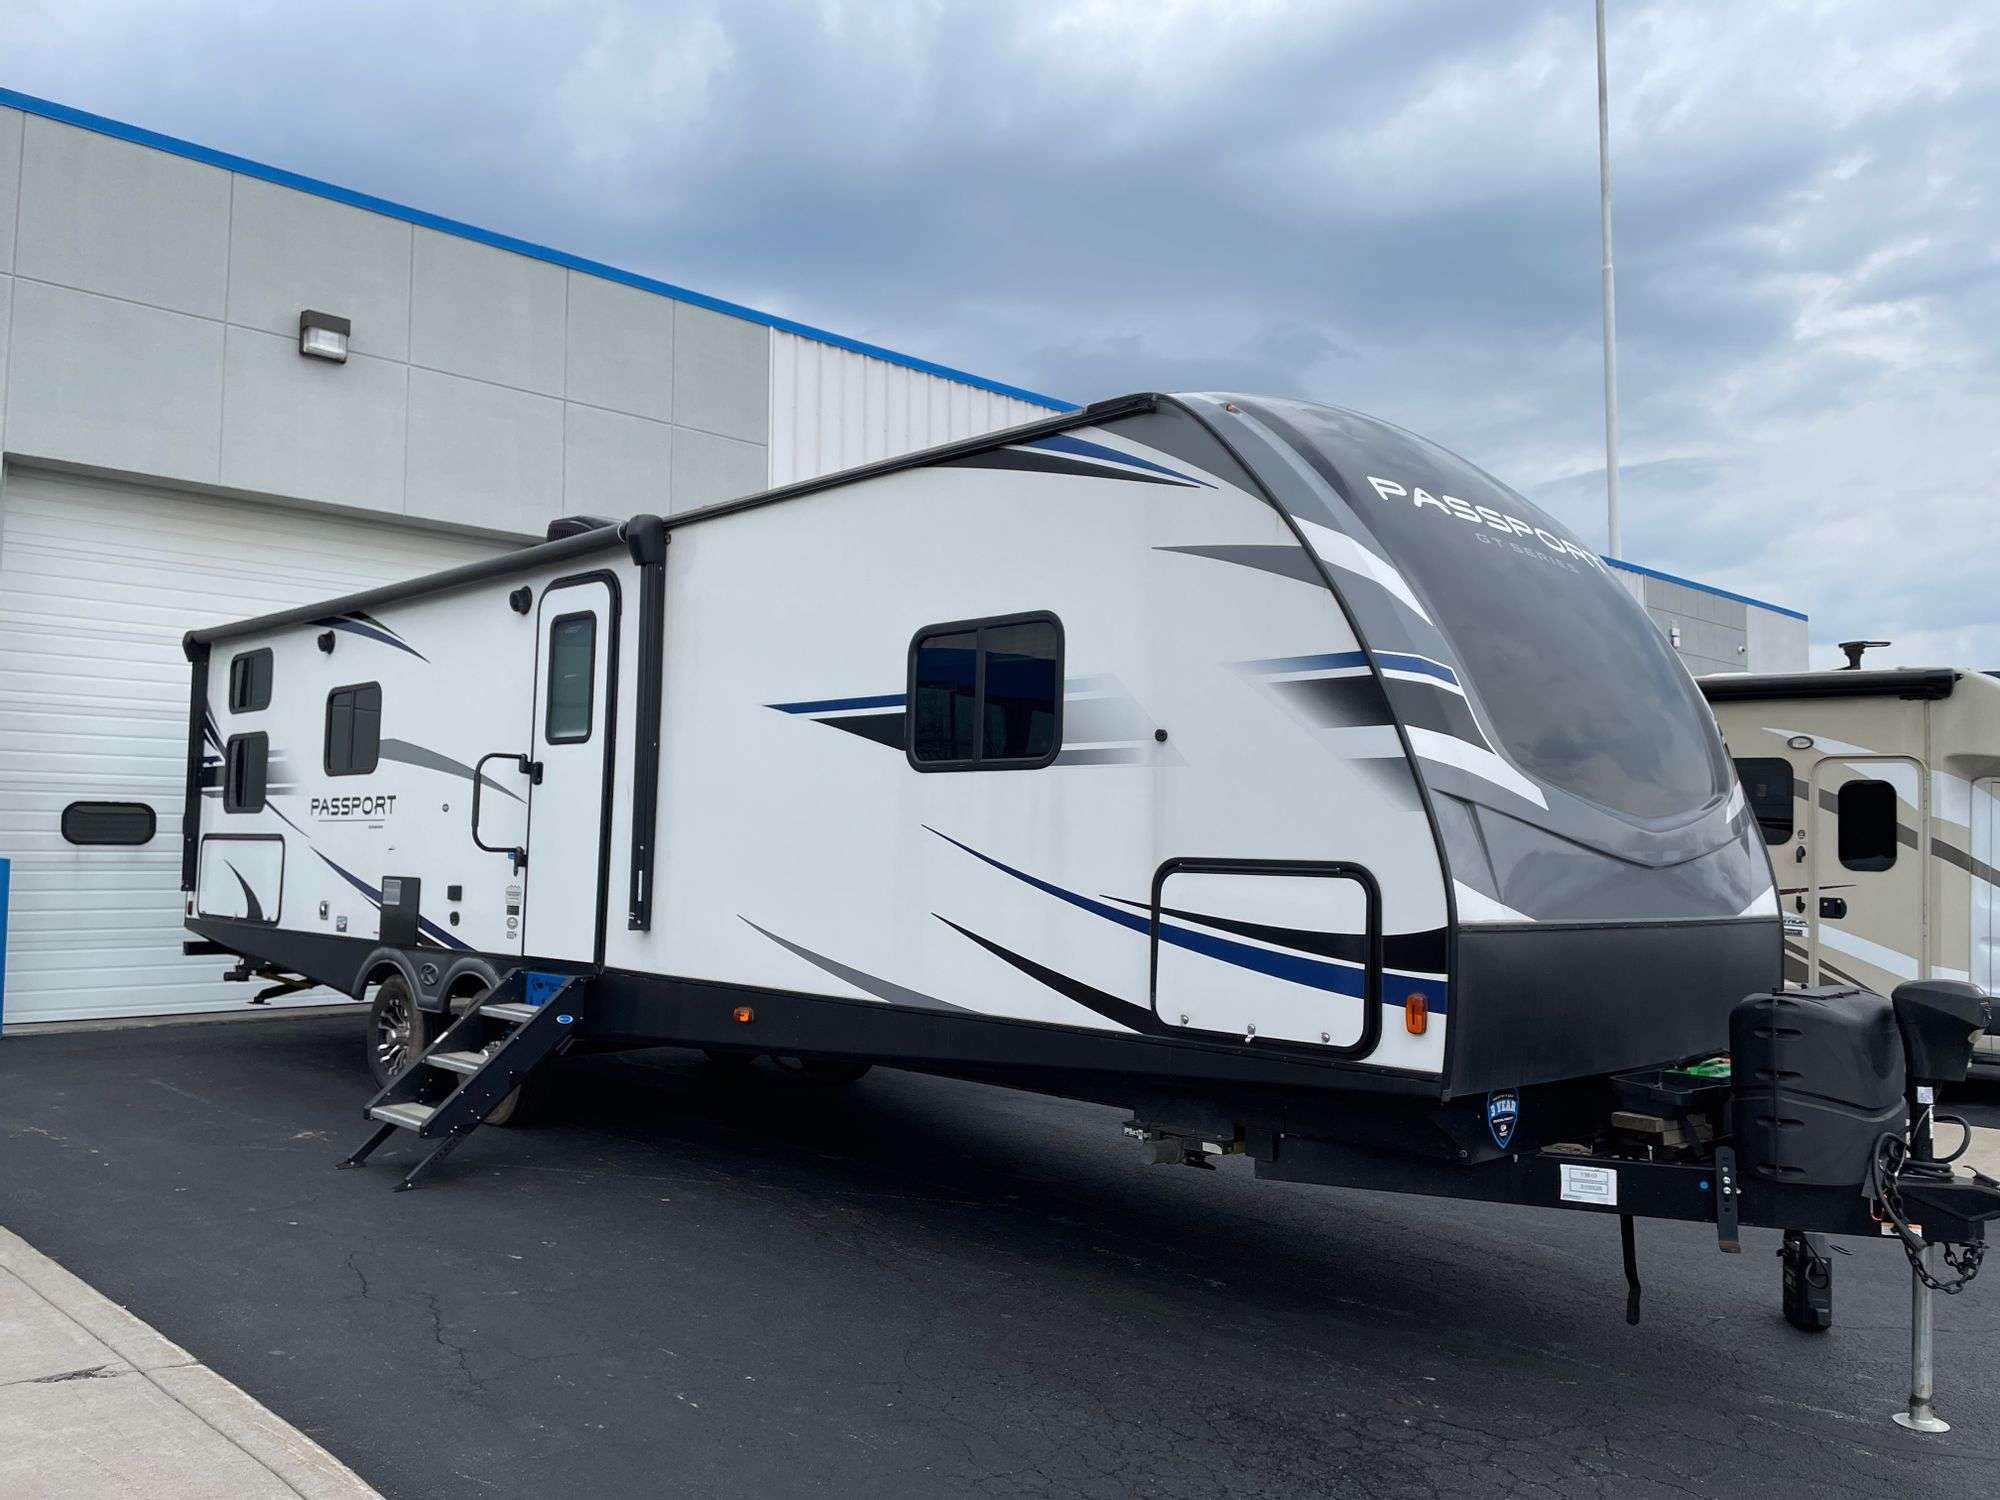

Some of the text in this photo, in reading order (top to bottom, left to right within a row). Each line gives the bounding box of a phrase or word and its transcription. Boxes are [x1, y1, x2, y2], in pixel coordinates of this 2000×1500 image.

[1367, 476, 1606, 573] PASSPORT
[310, 795, 397, 816] PASSPORT
[1496, 1100, 1516, 1113] YEAR
